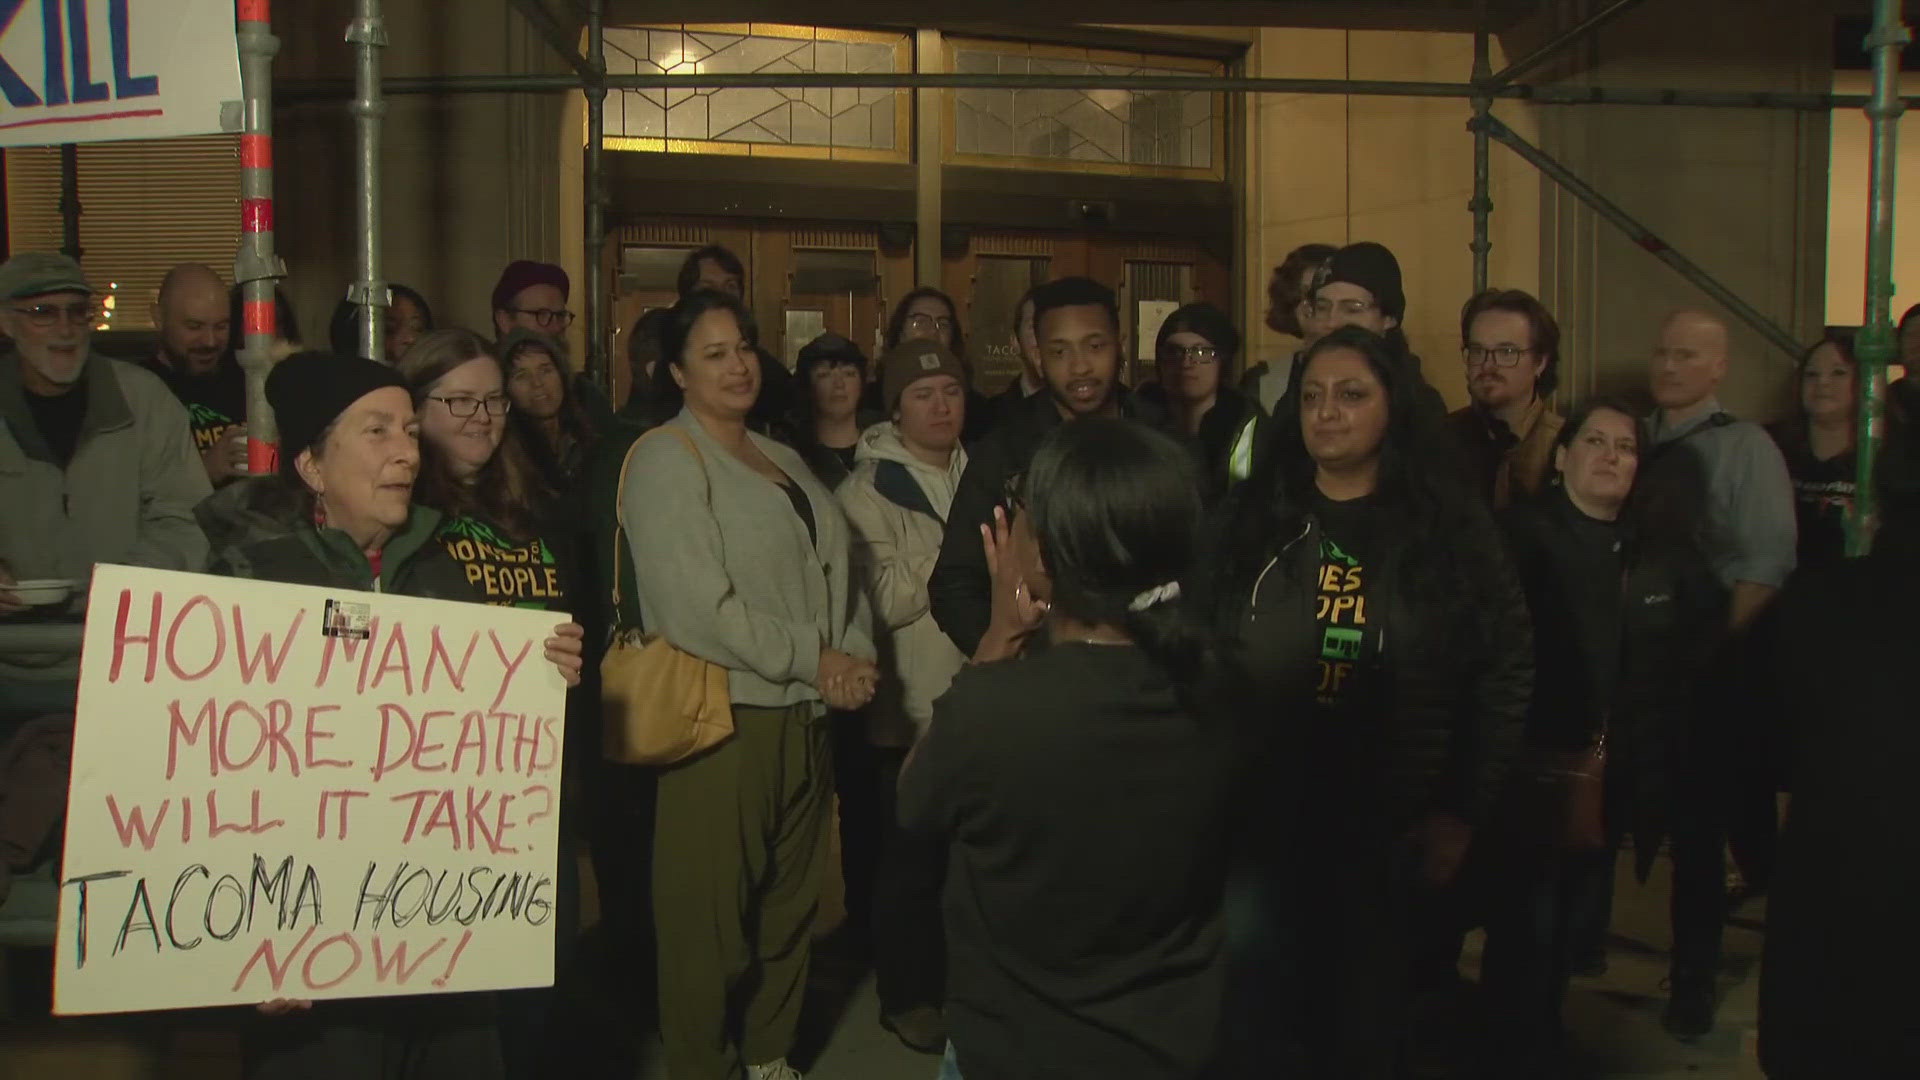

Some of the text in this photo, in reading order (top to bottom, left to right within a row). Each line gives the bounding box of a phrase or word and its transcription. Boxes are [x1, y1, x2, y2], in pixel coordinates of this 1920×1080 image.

[108, 588, 307, 684] HOW
[315, 616, 533, 714] MANY
[166, 698, 559, 781] MORE DEATHS
[105, 785, 554, 853] WILL IT TAKE?
[60, 853, 554, 970] TACOMA HOUSING
[232, 926, 473, 991] NOW!
